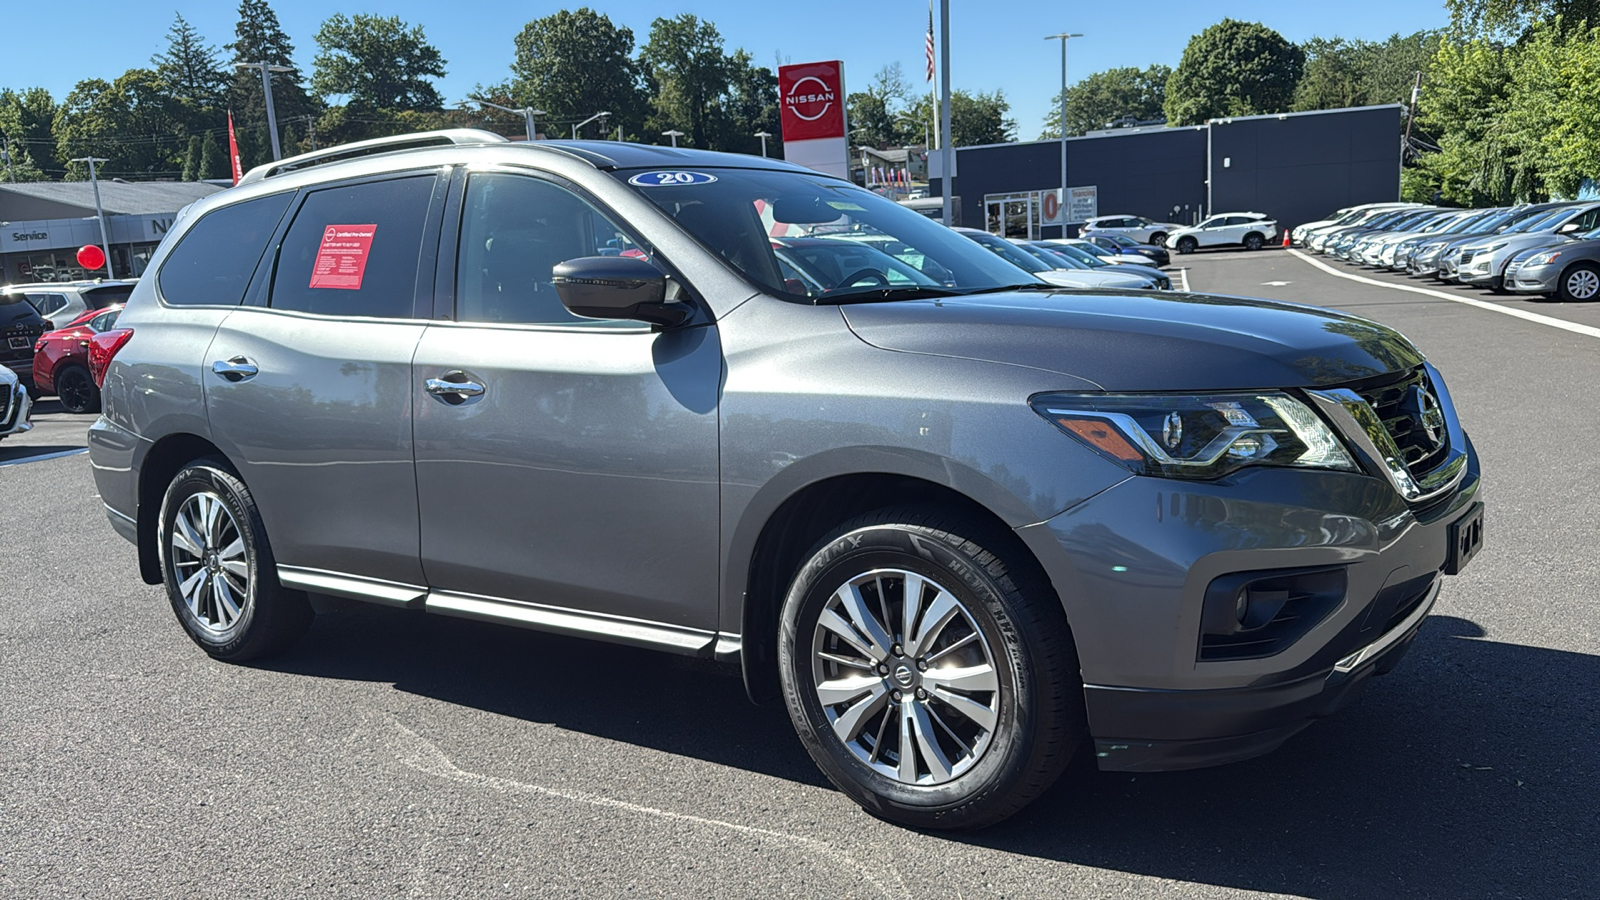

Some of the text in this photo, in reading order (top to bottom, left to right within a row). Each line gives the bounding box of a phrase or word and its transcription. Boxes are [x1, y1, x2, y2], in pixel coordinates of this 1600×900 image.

[786, 93, 834, 105] NISSAN
[656, 172, 694, 184] 20
[13, 230, 48, 242] Service
